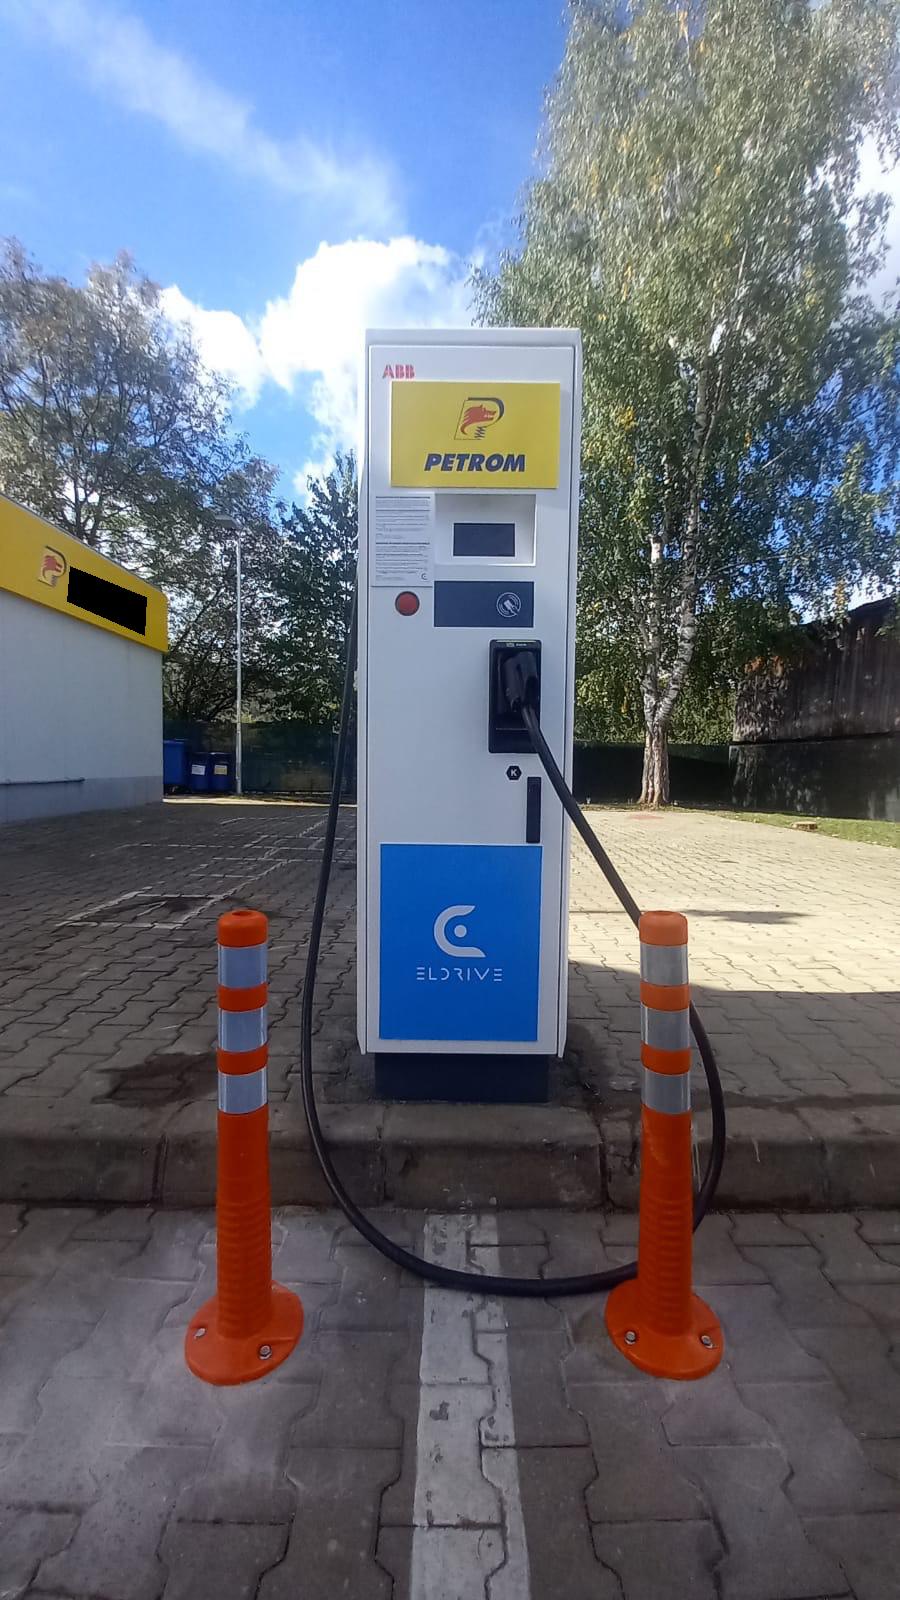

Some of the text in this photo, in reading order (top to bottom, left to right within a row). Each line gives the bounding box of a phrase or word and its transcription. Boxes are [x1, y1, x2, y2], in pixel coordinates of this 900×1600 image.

[382, 364, 415, 379] ABB
[424, 453, 526, 472] PETROM
[416, 966, 503, 982] ELDRIVE
